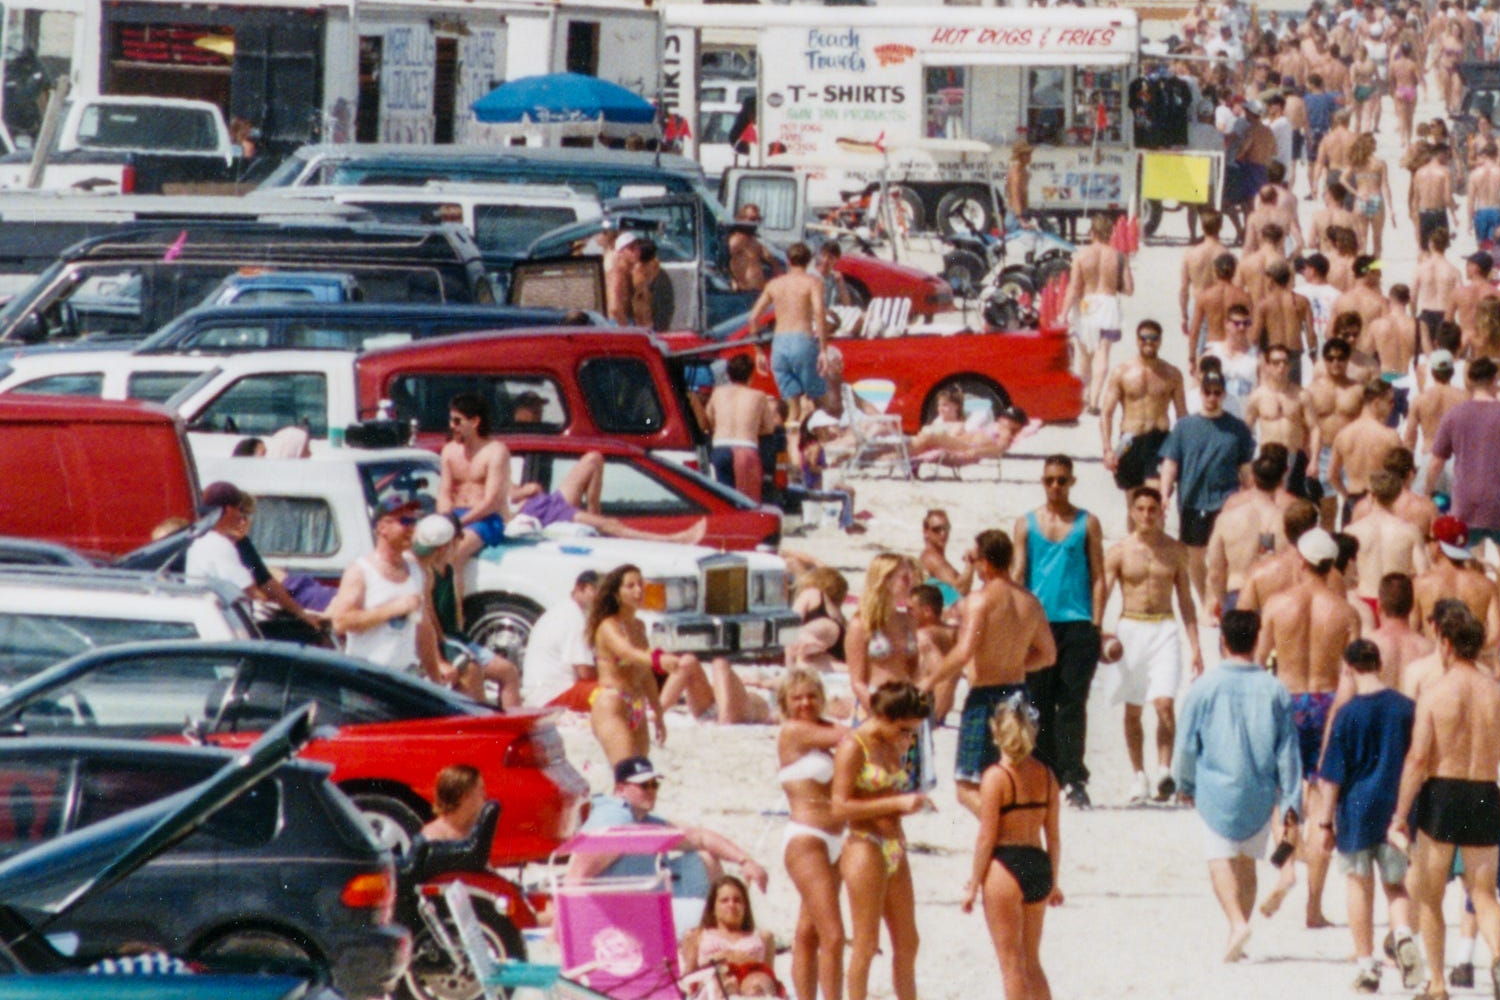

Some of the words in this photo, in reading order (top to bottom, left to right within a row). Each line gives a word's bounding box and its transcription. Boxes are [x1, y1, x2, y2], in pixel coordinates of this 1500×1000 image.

[808, 27, 860, 49] Beach
[931, 27, 976, 45] HOT
[977, 27, 1033, 46] DOGS
[1057, 28, 1116, 46] FRIES
[805, 50, 866, 72] Towels
